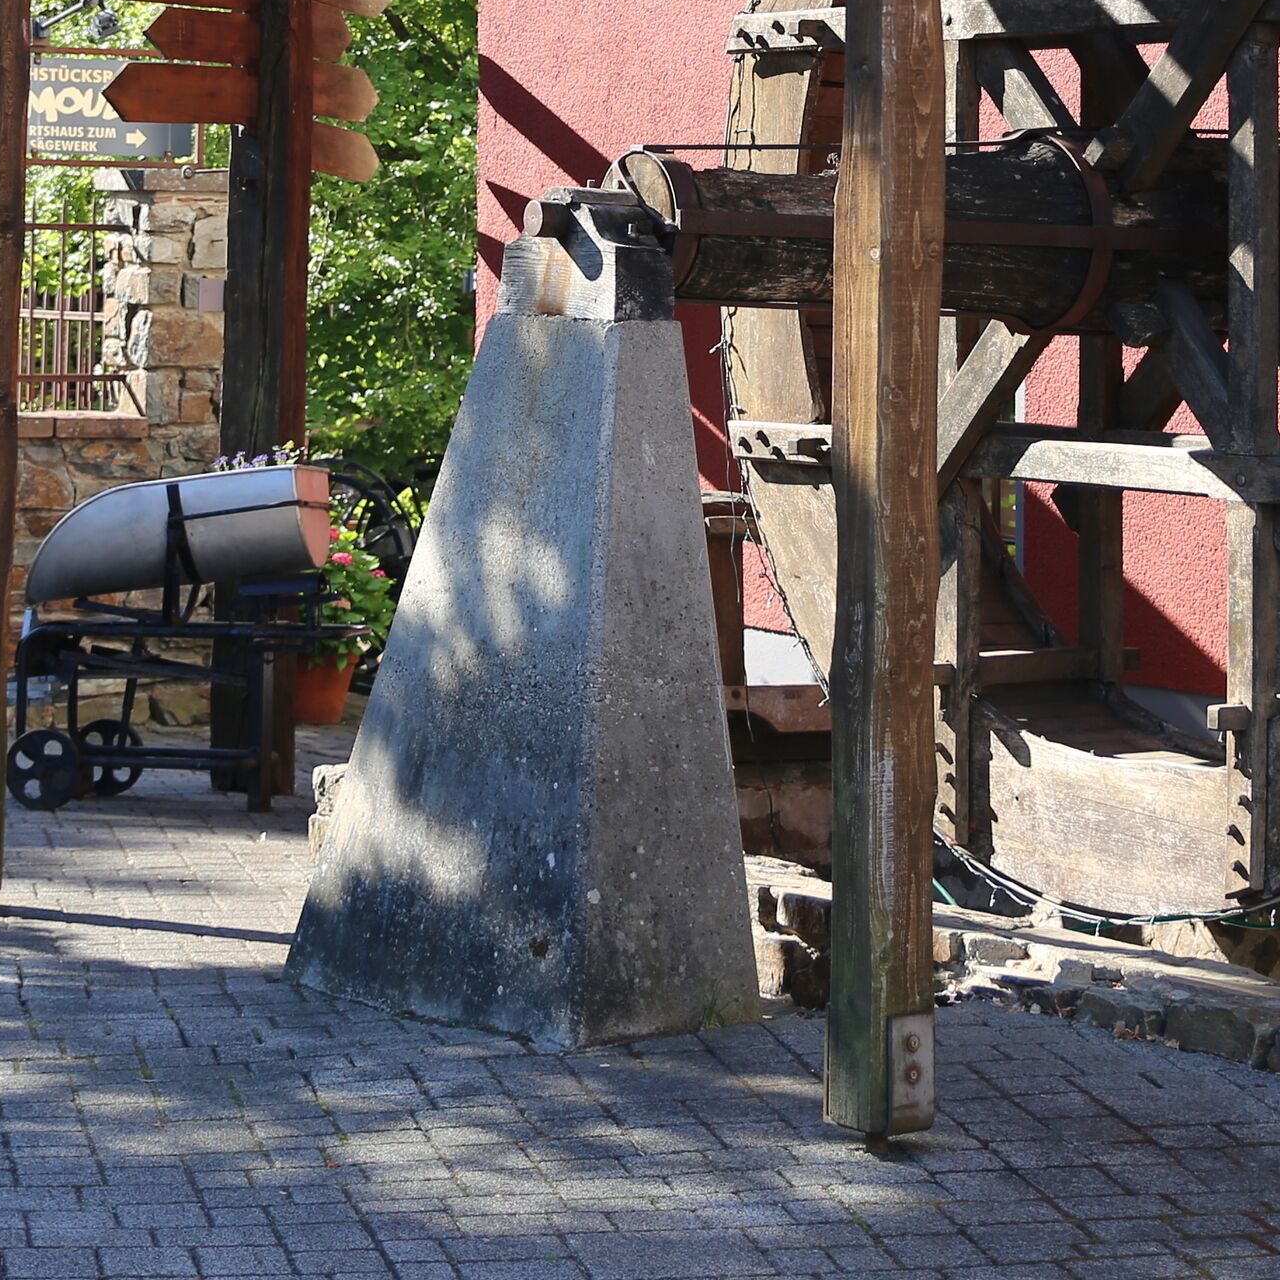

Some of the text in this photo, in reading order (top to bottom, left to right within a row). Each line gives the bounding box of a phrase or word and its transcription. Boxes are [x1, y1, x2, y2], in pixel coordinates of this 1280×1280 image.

[29, 125, 117, 139] RTSHAUS ZUM
[30, 137, 98, 152] SÄGEWERK
